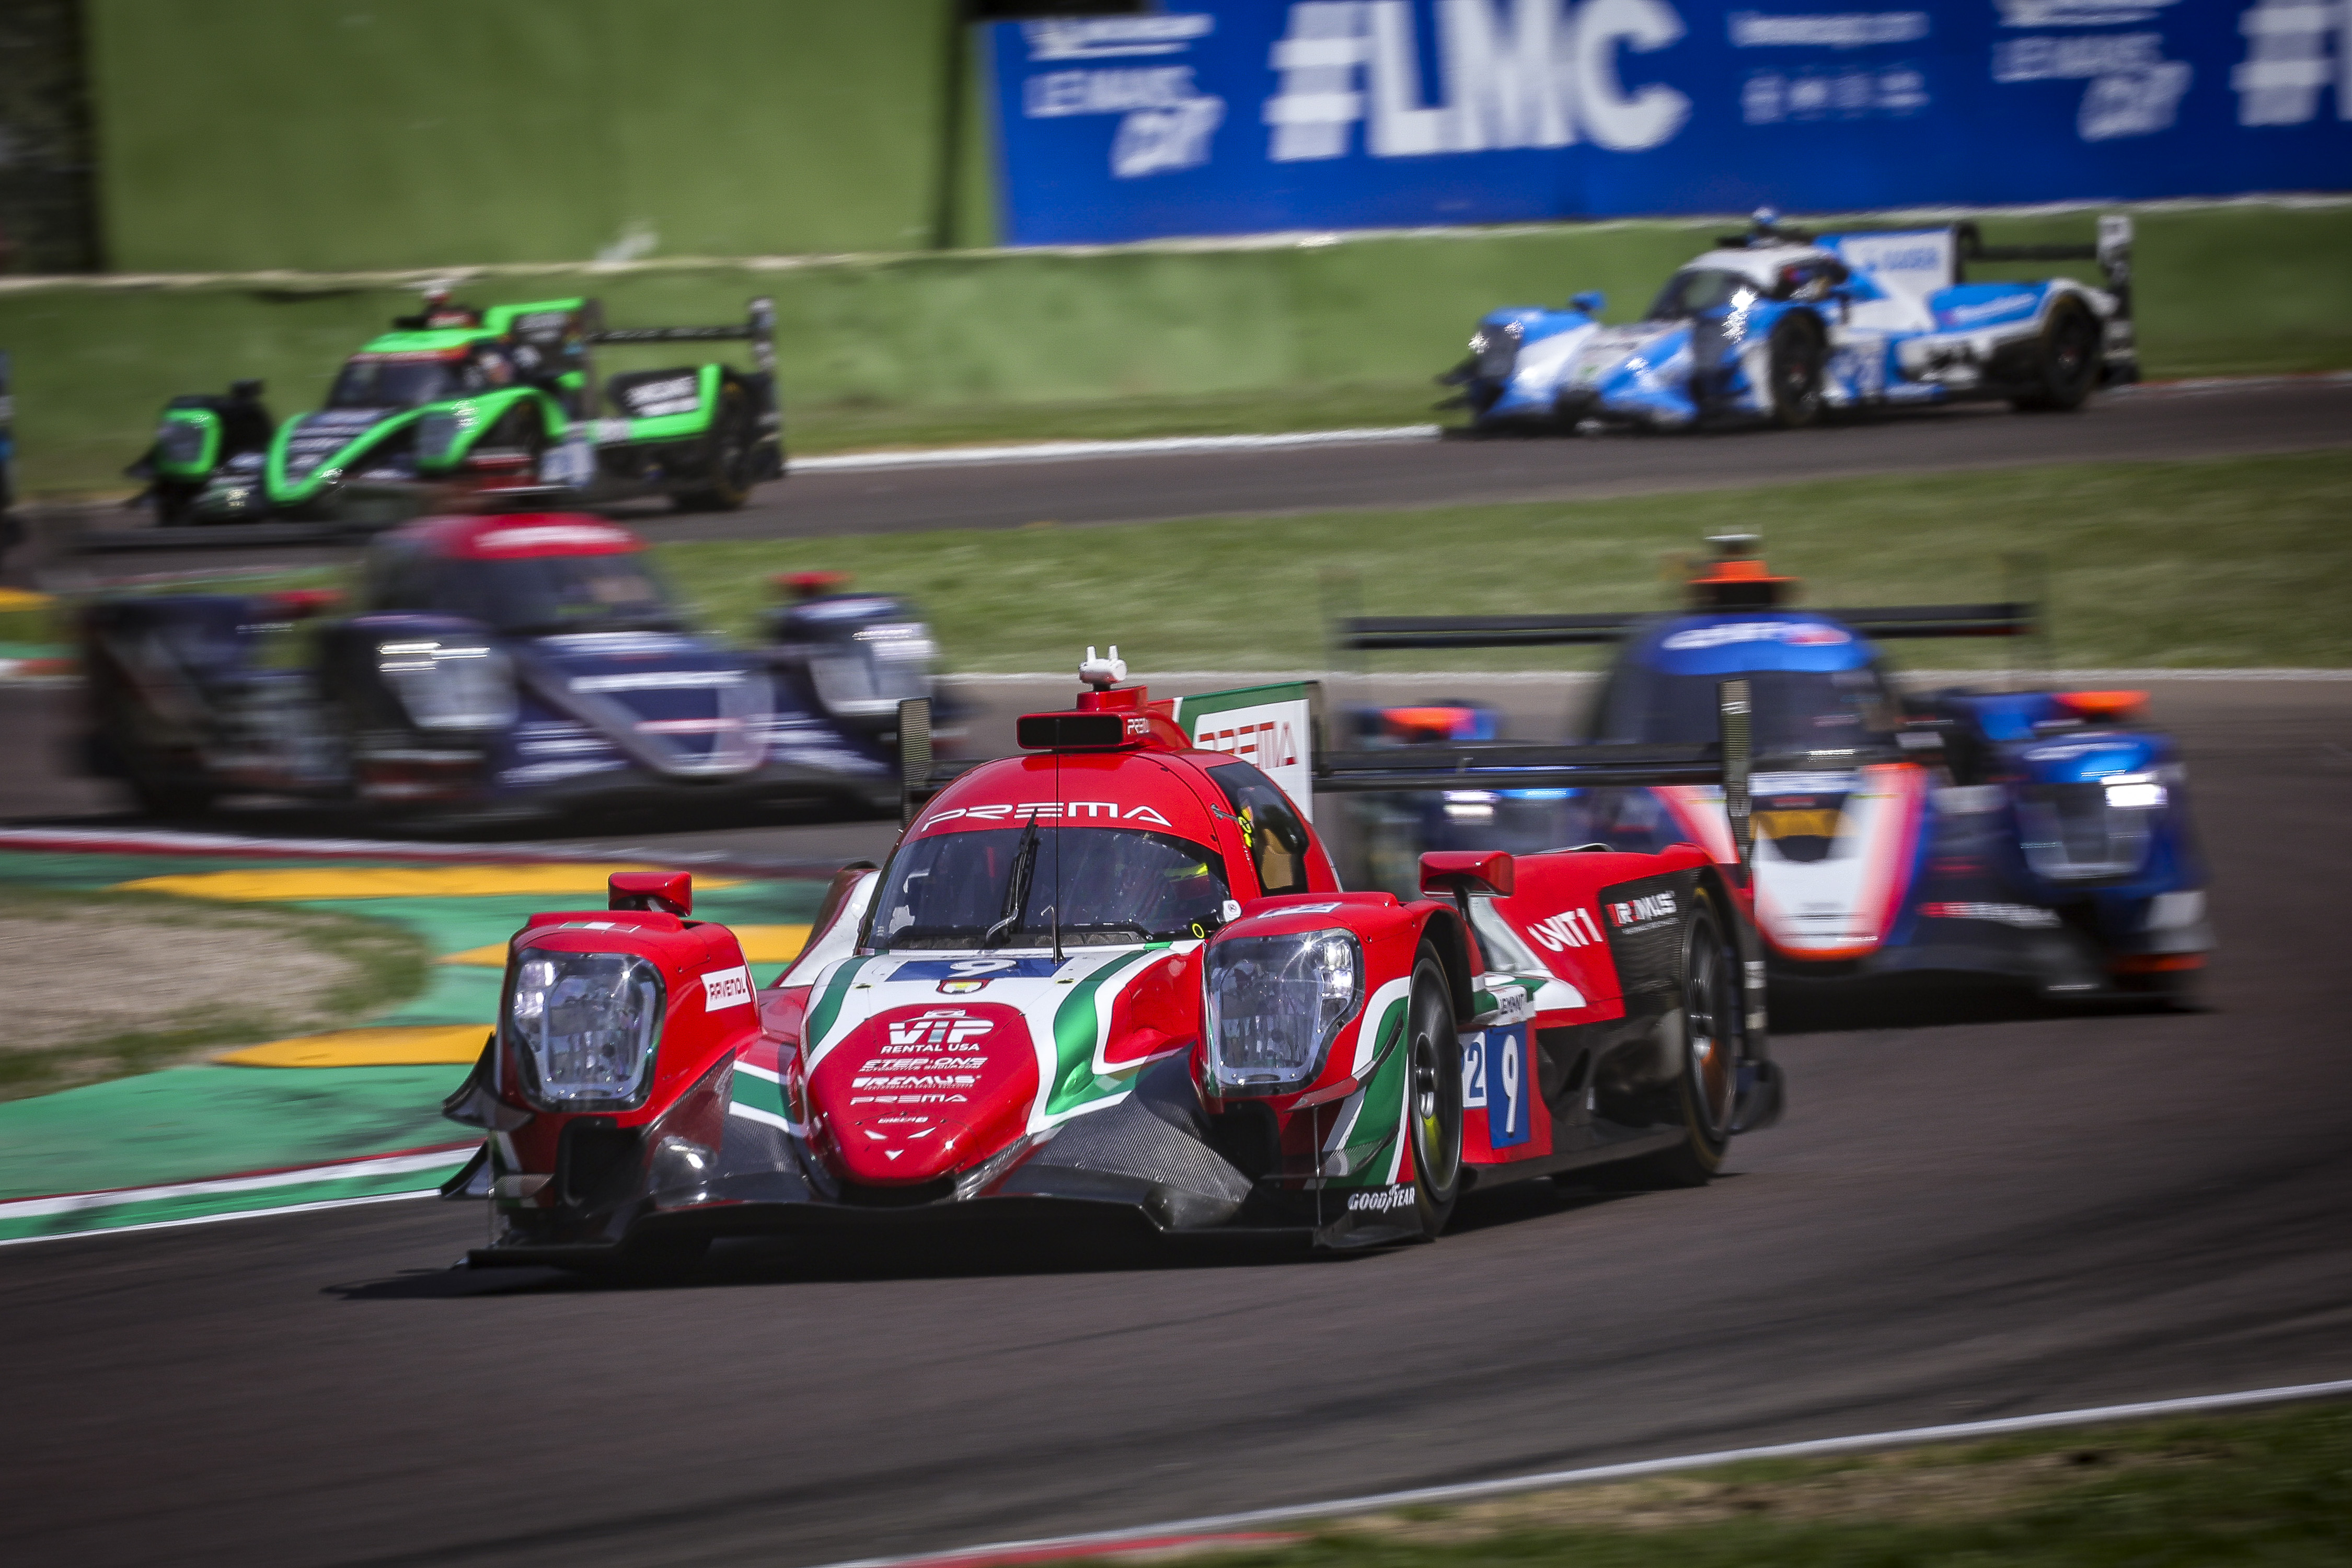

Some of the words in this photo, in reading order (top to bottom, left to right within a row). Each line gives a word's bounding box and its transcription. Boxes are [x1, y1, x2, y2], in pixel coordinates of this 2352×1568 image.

[1264, 0, 1691, 161] #LMC
[921, 801, 1172, 833] PREMA
[709, 977, 746, 1001] RAVENOL
[880, 1045, 943, 1054] RENTAL
[948, 1043, 981, 1052] USA
[865, 1075, 976, 1087] REMUS
[1461, 1042, 1484, 1098] 2
[1502, 1034, 1519, 1133] 9
[850, 1094, 967, 1105] PREMA
[1347, 1183, 1415, 1213] GOODYEAR
